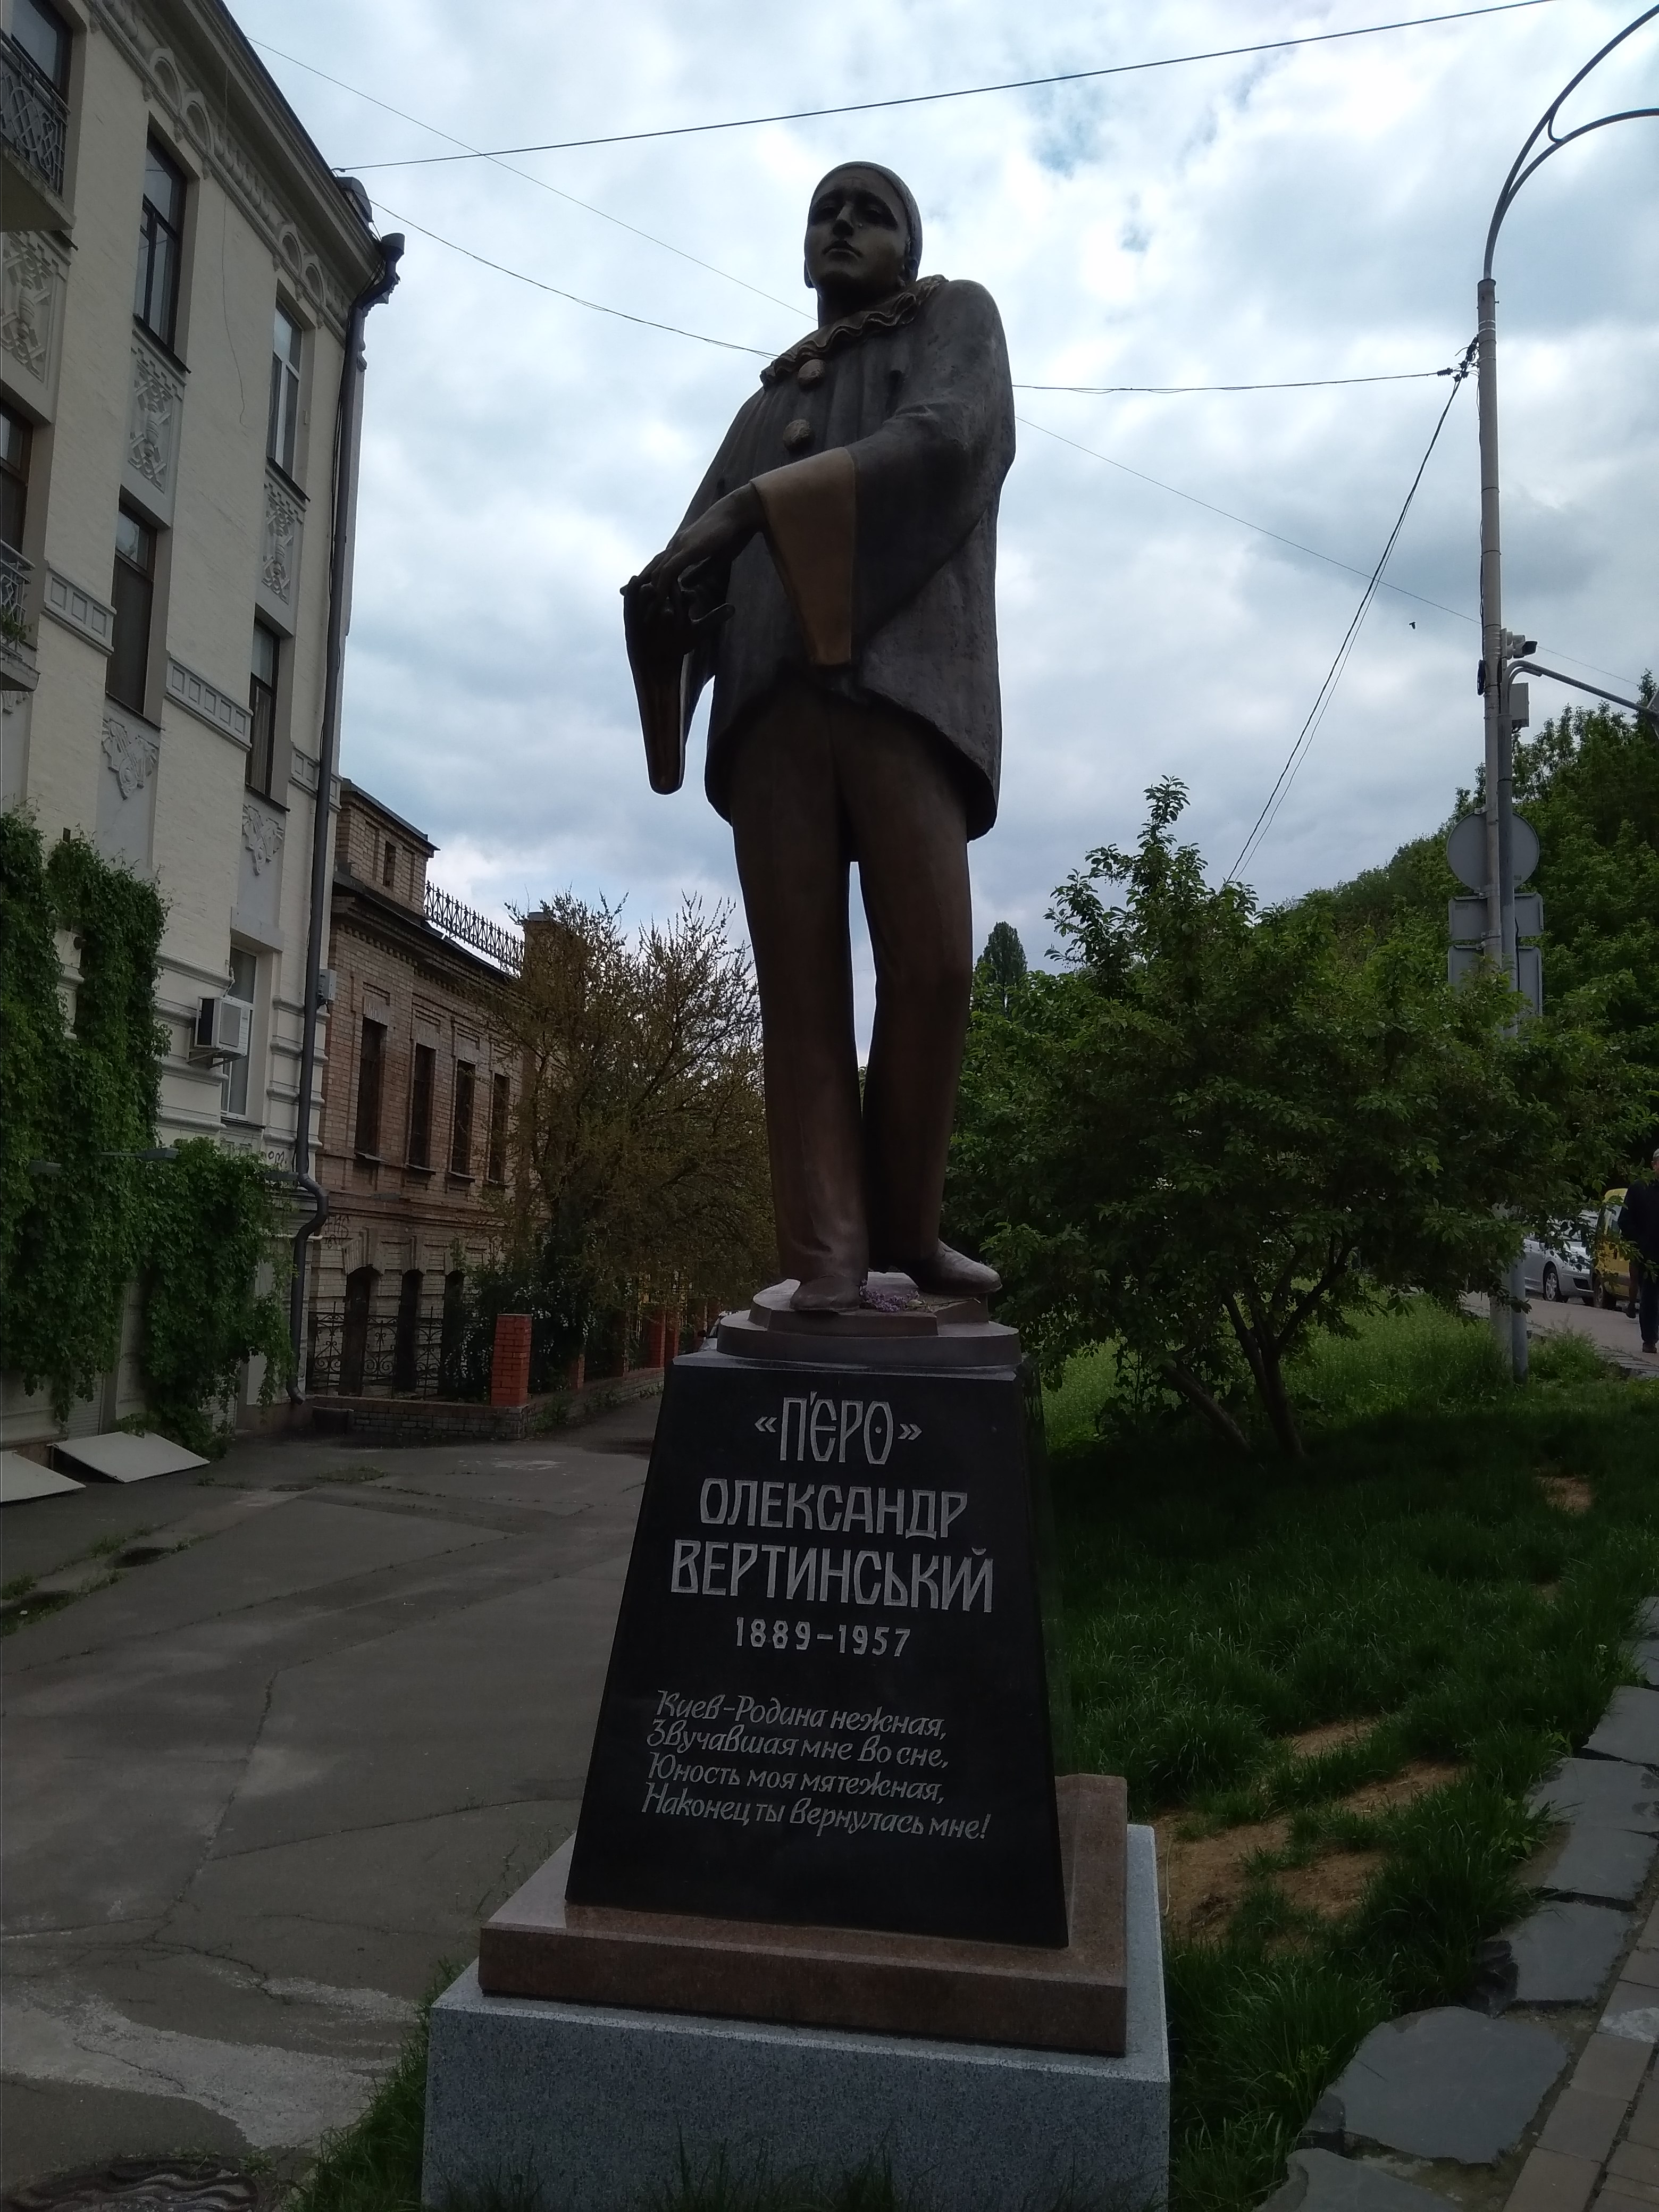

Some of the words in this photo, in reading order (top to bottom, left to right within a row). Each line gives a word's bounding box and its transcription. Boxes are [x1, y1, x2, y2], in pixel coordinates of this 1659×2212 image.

[700, 1478, 968, 1540] ОЛЕКСАНДР
[671, 1539, 994, 1613] ВЕРТИНСЬКИЙ
[647, 1718, 800, 1756] Звучавшая
[800, 1739, 853, 1762] мне
[896, 1747, 949, 1769] сне,
[830, 1706, 947, 1740] нежная,
[648, 1752, 740, 1786] Юность
[747, 1769, 798, 1789] моя
[800, 1770, 944, 1805] мятежная,
[756, 1803, 786, 1823] ты
[928, 1813, 992, 1840] мне!
